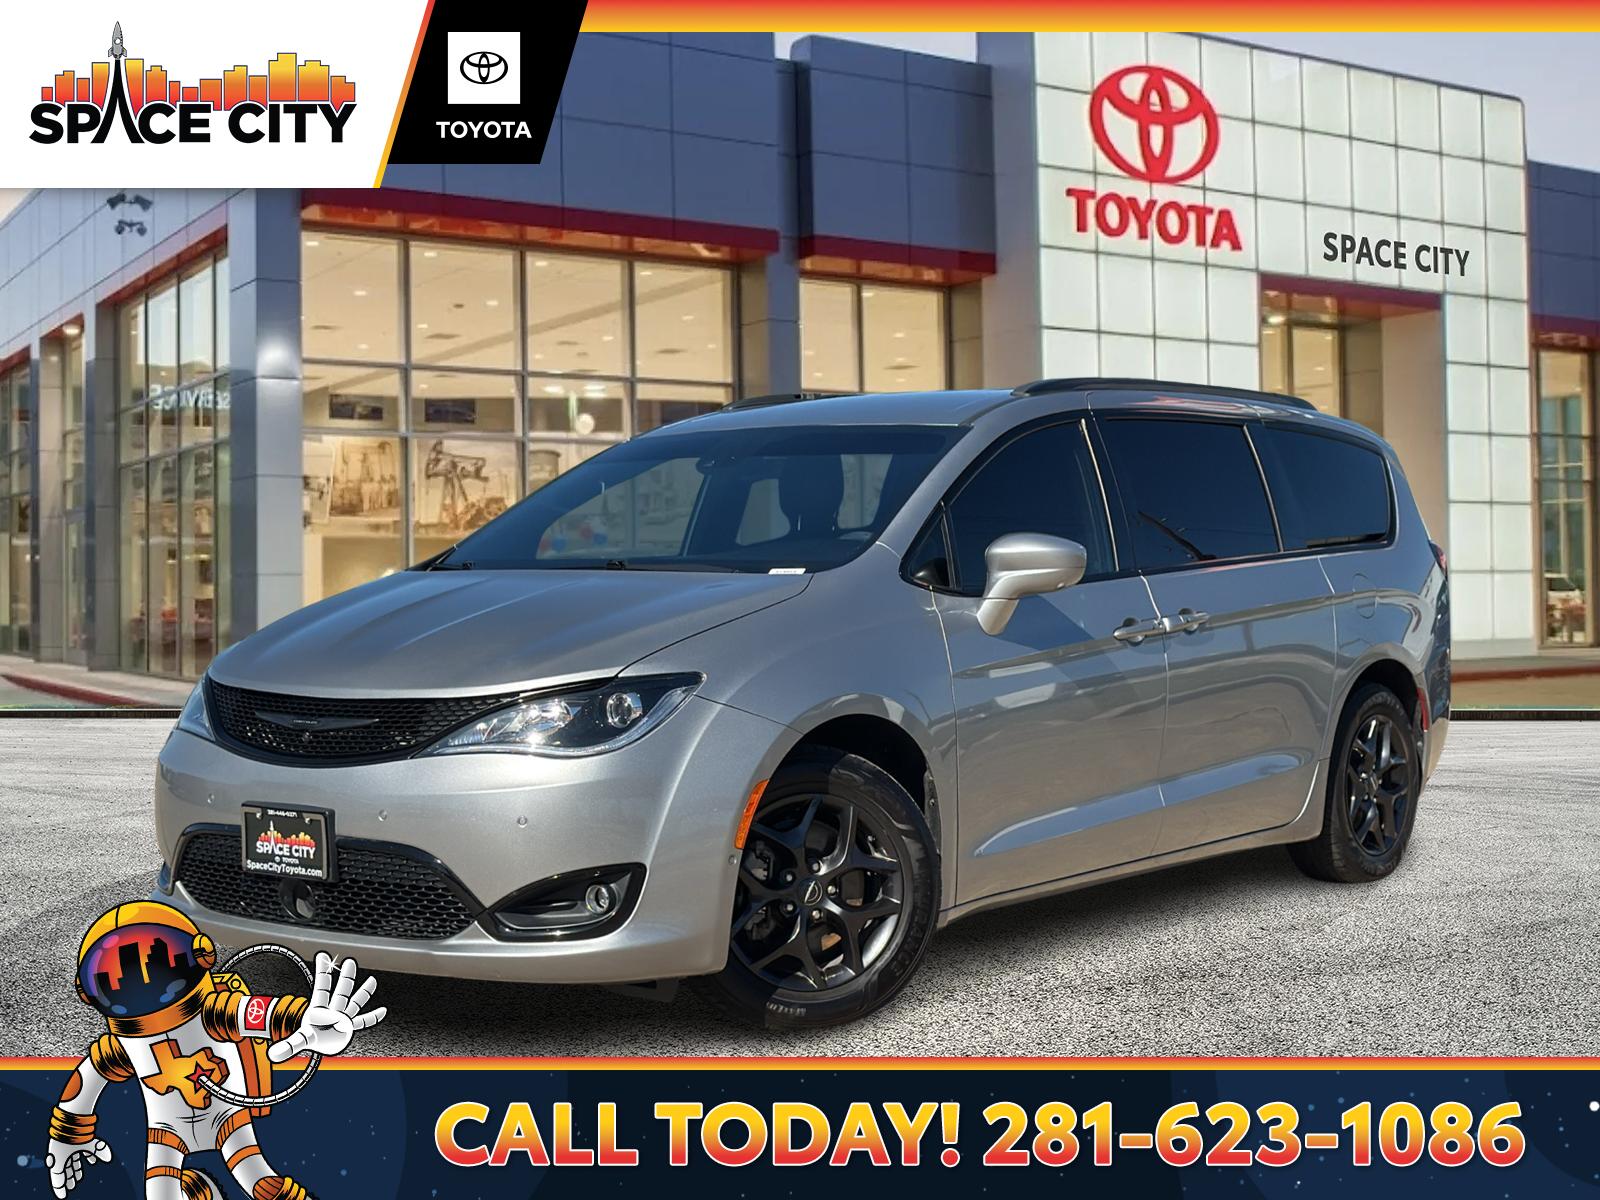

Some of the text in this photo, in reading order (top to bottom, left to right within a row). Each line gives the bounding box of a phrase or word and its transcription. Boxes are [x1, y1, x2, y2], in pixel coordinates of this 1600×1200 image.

[1066, 187, 1243, 251] TOYOTA
[1323, 231, 1470, 277] SPACE CITY
[256, 840, 316, 859] SPACE CITY
[246, 859, 323, 877] SpaceCityToyota.com
